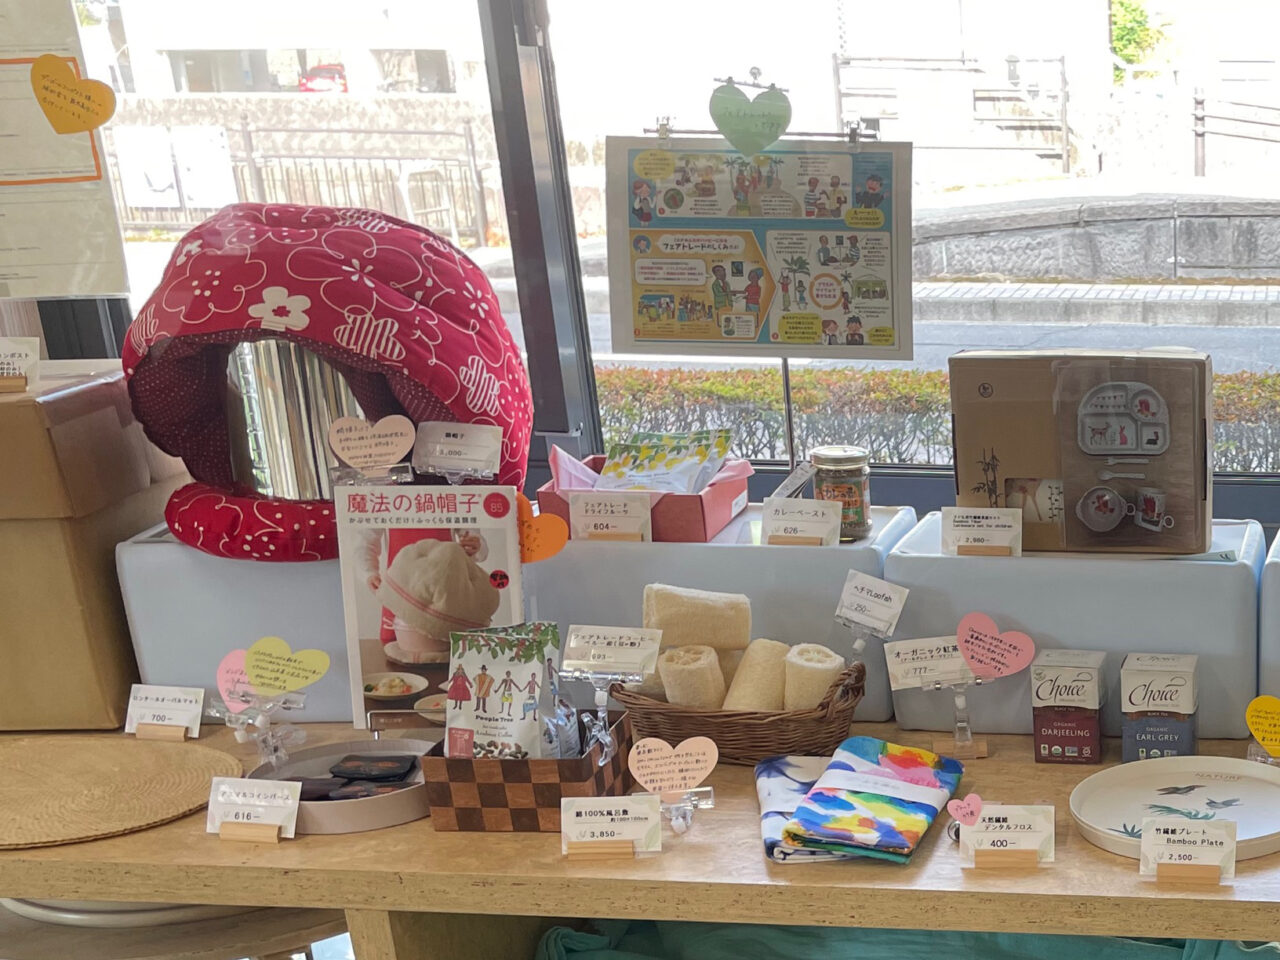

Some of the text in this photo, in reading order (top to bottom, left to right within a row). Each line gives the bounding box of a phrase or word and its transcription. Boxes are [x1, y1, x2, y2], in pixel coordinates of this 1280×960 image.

[0, 352, 29, 360] ンポスト
[347, 492, 480, 514] 魔法の鍋帽子
[773, 508, 827, 518] カレーペースト
[1036, 673, 1091, 703] Choice
[1129, 677, 1185, 708] Choice
[475, 714, 499, 722] People
[1041, 728, 1090, 737] DARJEELING
[1136, 733, 1156, 741] EARL
[984, 823, 1033, 831] デンタルフロス
[1166, 838, 1224, 847] Bamboo Plate
